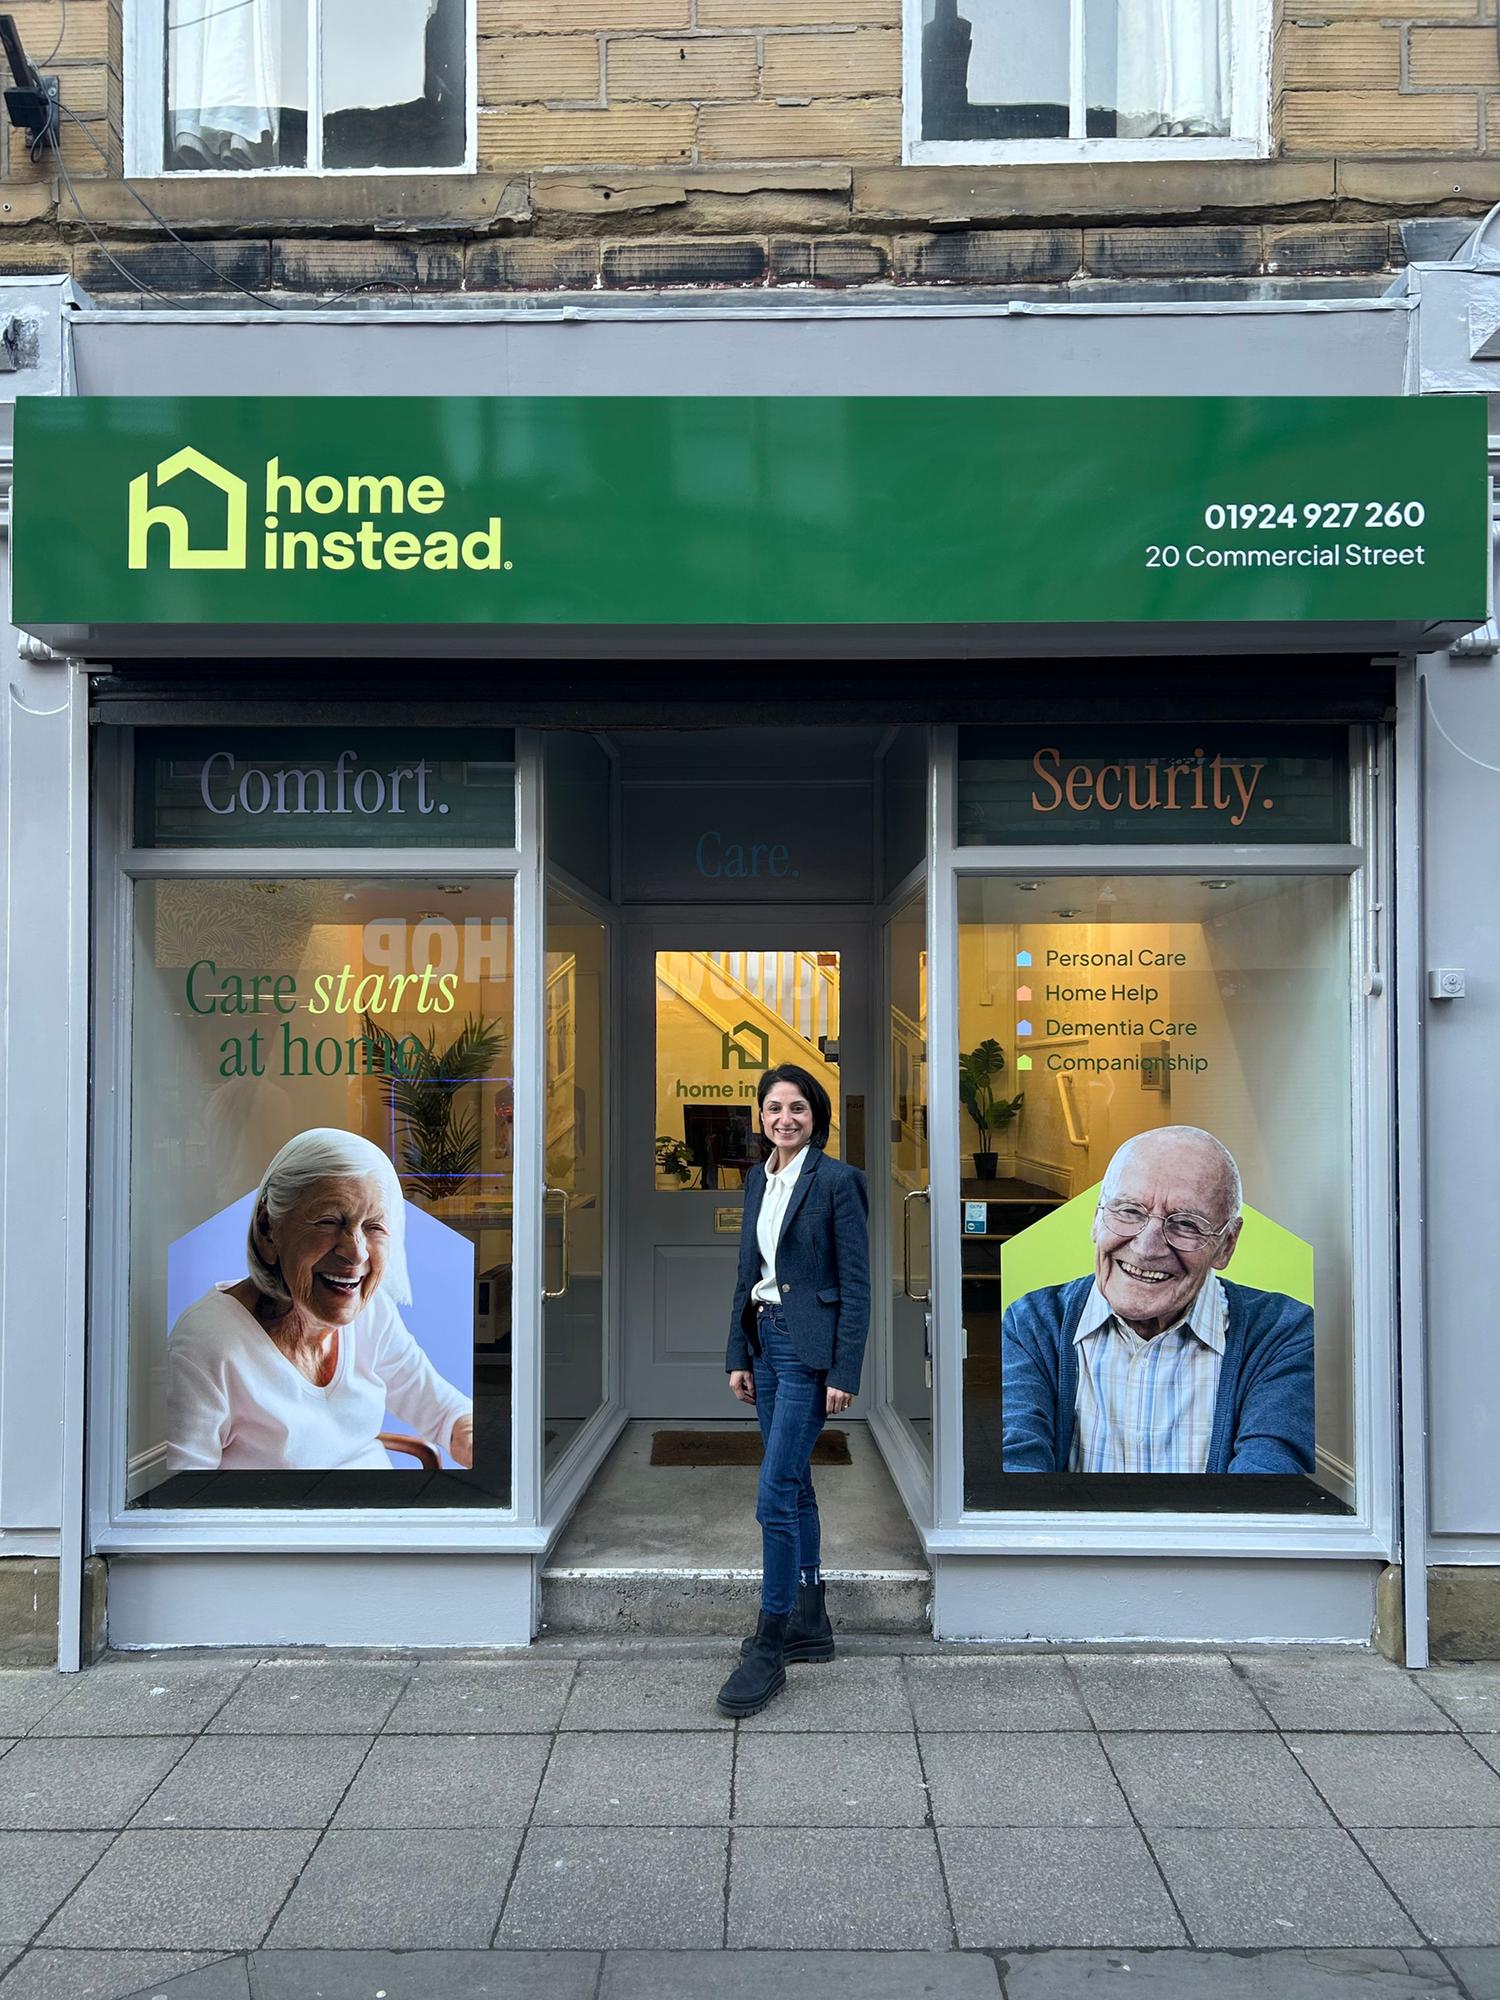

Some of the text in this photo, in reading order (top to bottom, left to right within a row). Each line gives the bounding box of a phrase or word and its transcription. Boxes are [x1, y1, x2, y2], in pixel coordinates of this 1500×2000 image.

[266, 456, 445, 515] home
[1204, 501, 1425, 530] 01924 927 260
[1145, 544, 1425, 567] 20 Commercial Street
[201, 750, 450, 815] Comfort.
[1032, 747, 1274, 826] Security.
[696, 831, 800, 879] Care.
[1046, 949, 1186, 966] Personal Care
[186, 959, 459, 1015] Care starts
[1045, 983, 1159, 1005] Home Help
[1045, 1019, 1198, 1037] Dementia Care
[219, 1021, 421, 1078] at home
[1046, 1053, 1209, 1073] Companionship
[676, 1079, 734, 1098] home
